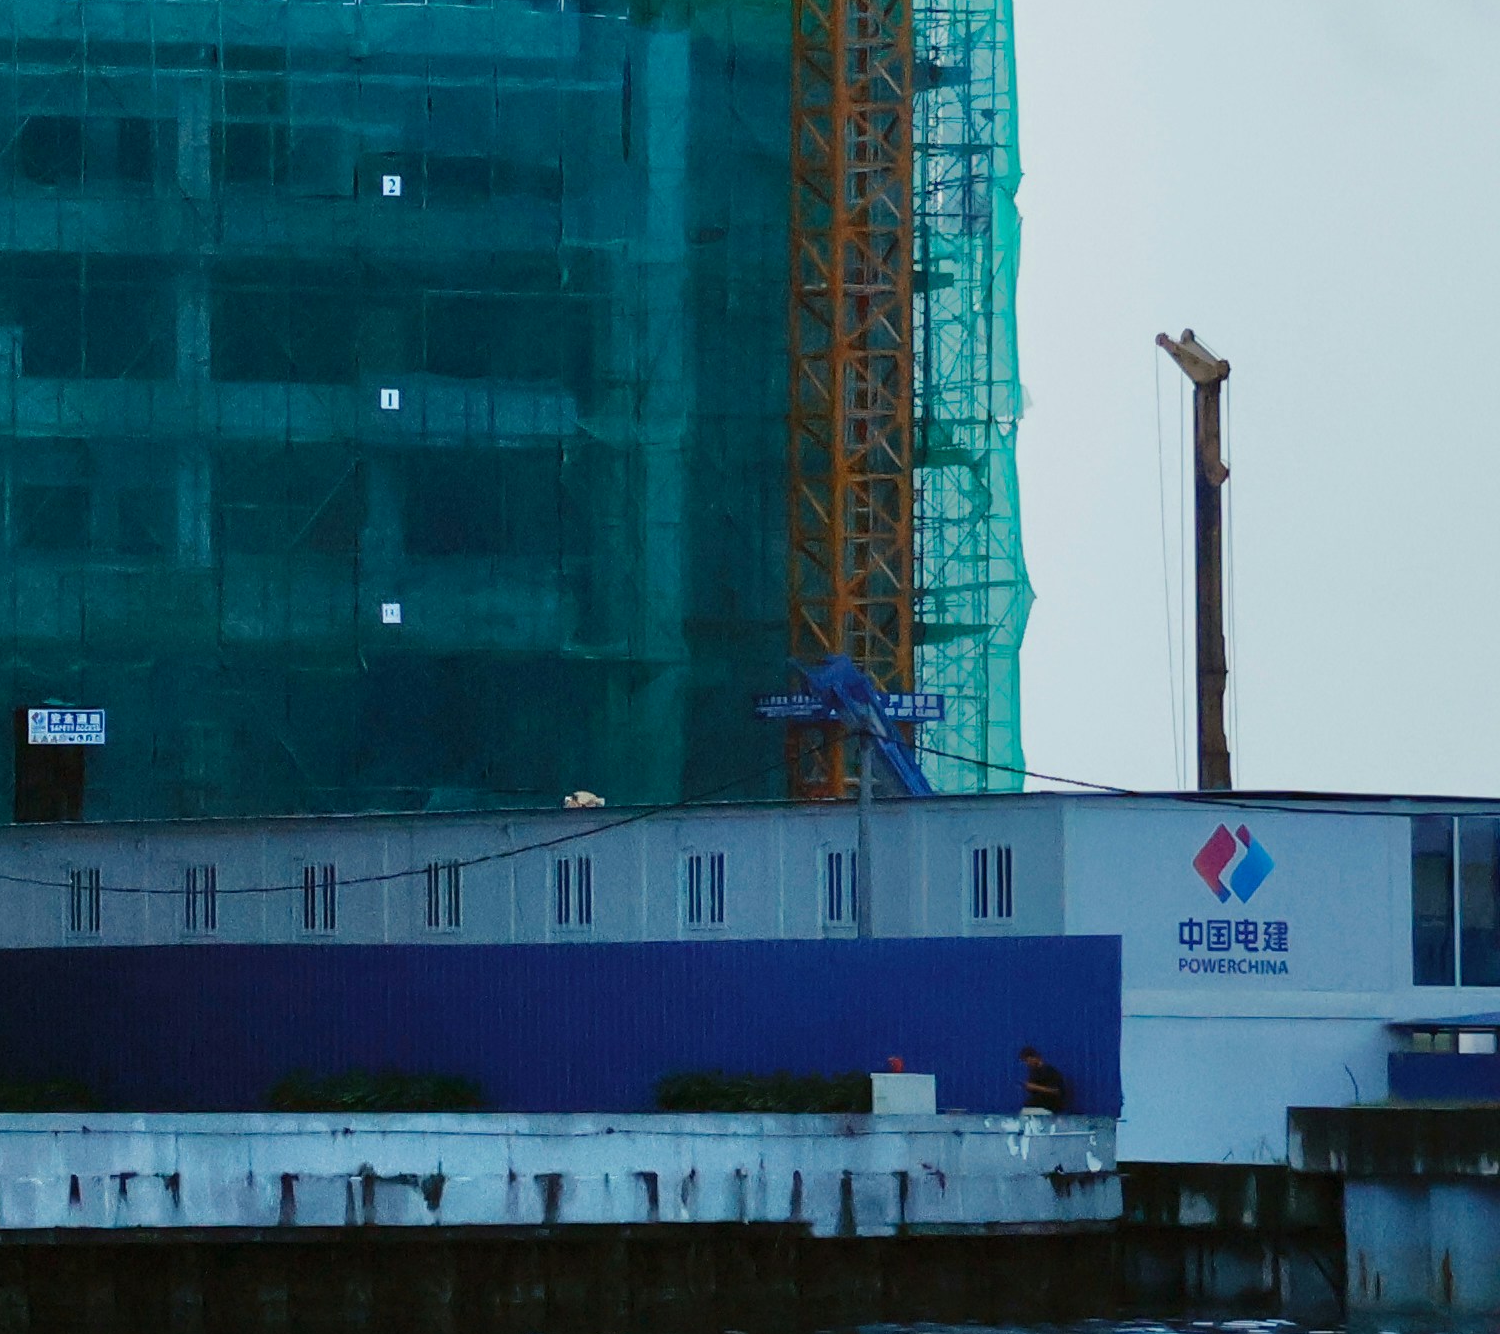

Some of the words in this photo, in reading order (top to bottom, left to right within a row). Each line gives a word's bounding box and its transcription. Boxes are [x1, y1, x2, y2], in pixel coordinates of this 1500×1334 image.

[1178, 918, 1289, 952] 中国电建
[1178, 958, 1289, 975] POWERCHINA
